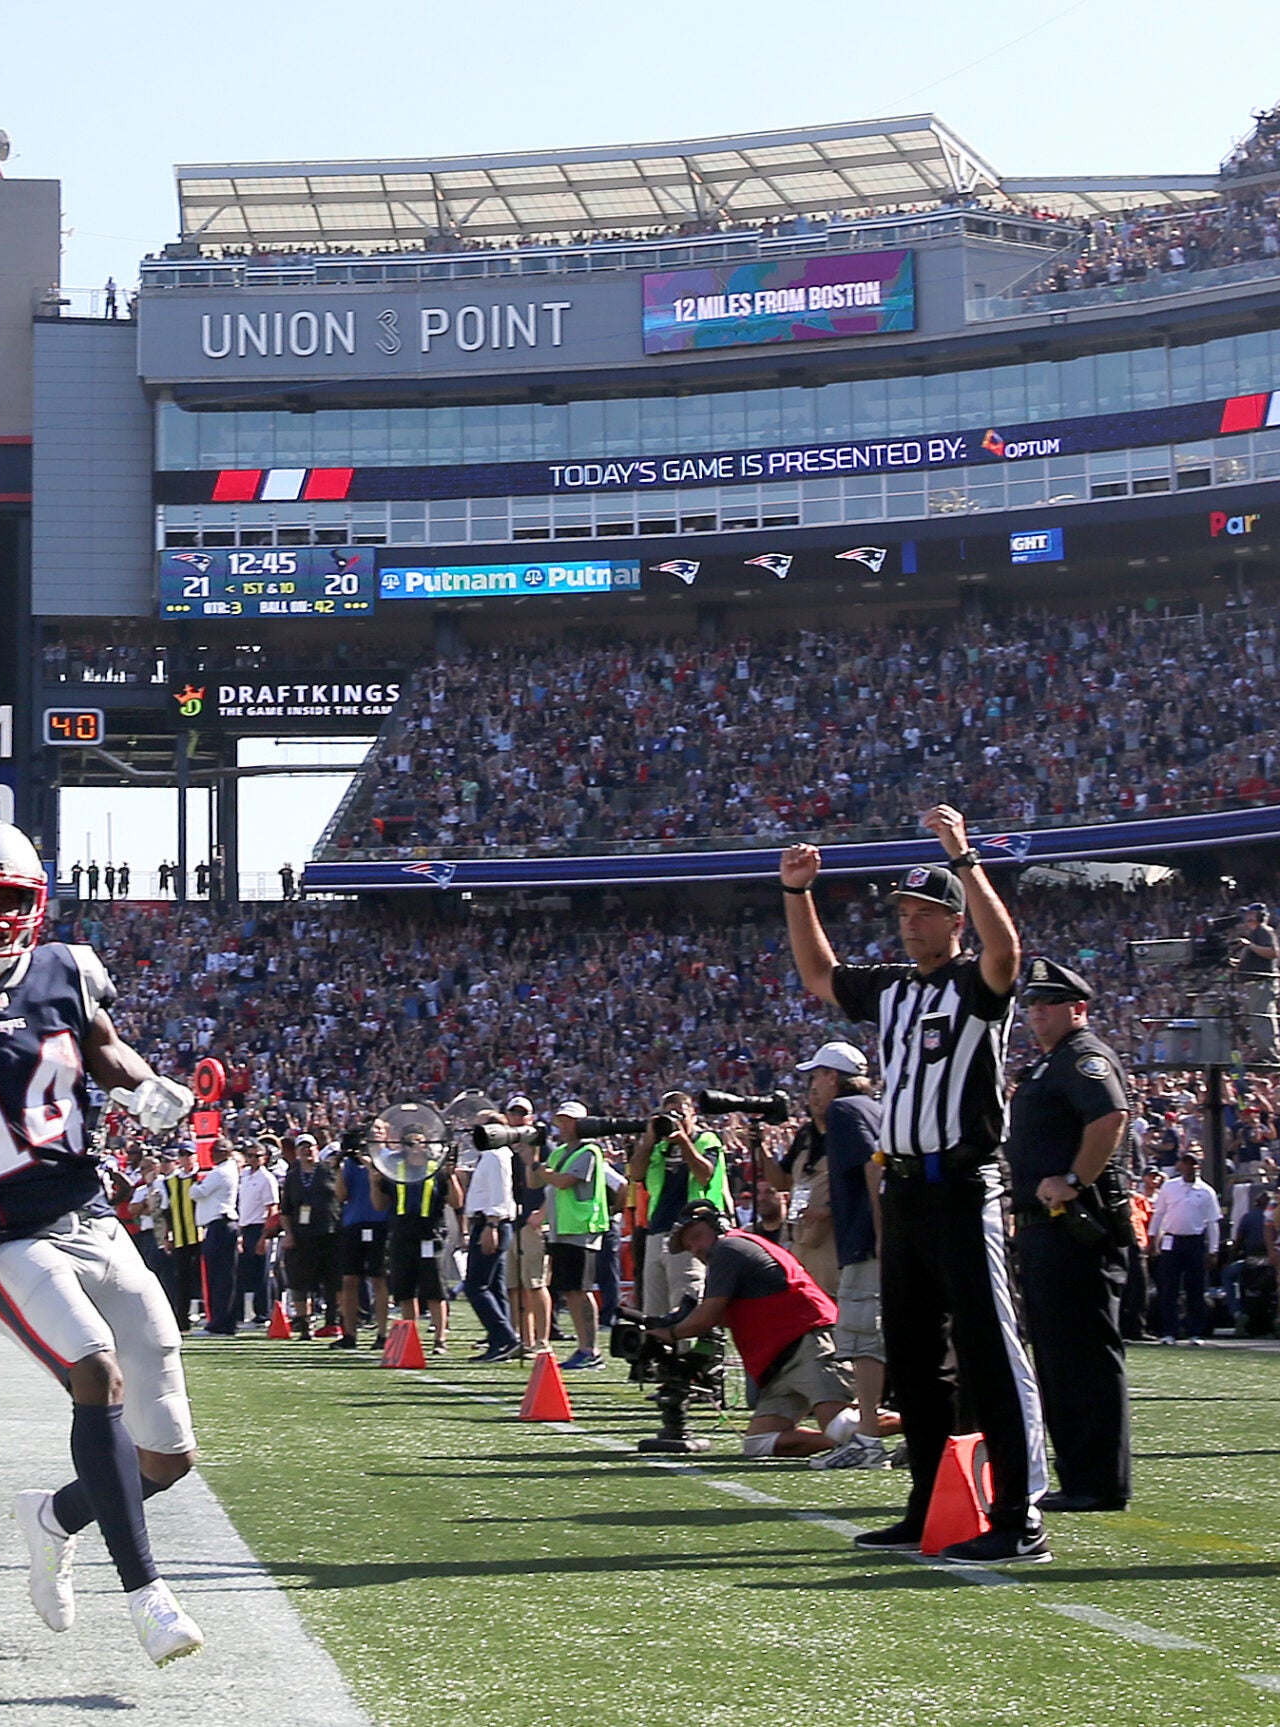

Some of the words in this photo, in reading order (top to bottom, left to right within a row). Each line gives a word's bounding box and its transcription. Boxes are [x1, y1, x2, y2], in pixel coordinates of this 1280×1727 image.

[672, 297, 696, 322] 12
[696, 292, 752, 321] MILES
[754, 286, 806, 315] FROM
[808, 280, 882, 311] BOSTON
[201, 310, 356, 359] UNION
[419, 301, 572, 353] POINT
[549, 461, 658, 487] TODAY'S
[662, 456, 734, 482] GAME
[740, 453, 763, 477] IS
[769, 441, 921, 475] PRESENTED
[928, 436, 968, 462] BY:
[1004, 438, 1061, 459] OPTUM
[1208, 511, 1261, 538] Par
[228, 551, 298, 576] 12:45
[182, 575, 211, 598] 21
[242, 582, 265, 595] 1ST
[266, 582, 278, 594] &
[279, 581, 296, 595] 10
[323, 573, 360, 597] 20
[404, 570, 518, 593] Putnam
[258, 600, 289, 614] BALL
[218, 683, 401, 705] DRAFTKINGS
[218, 706, 244, 717] THE
[246, 705, 285, 717] GAME
[286, 704, 332, 716] INSIDE
[334, 704, 360, 716] THE
[51, 714, 97, 740] 40
